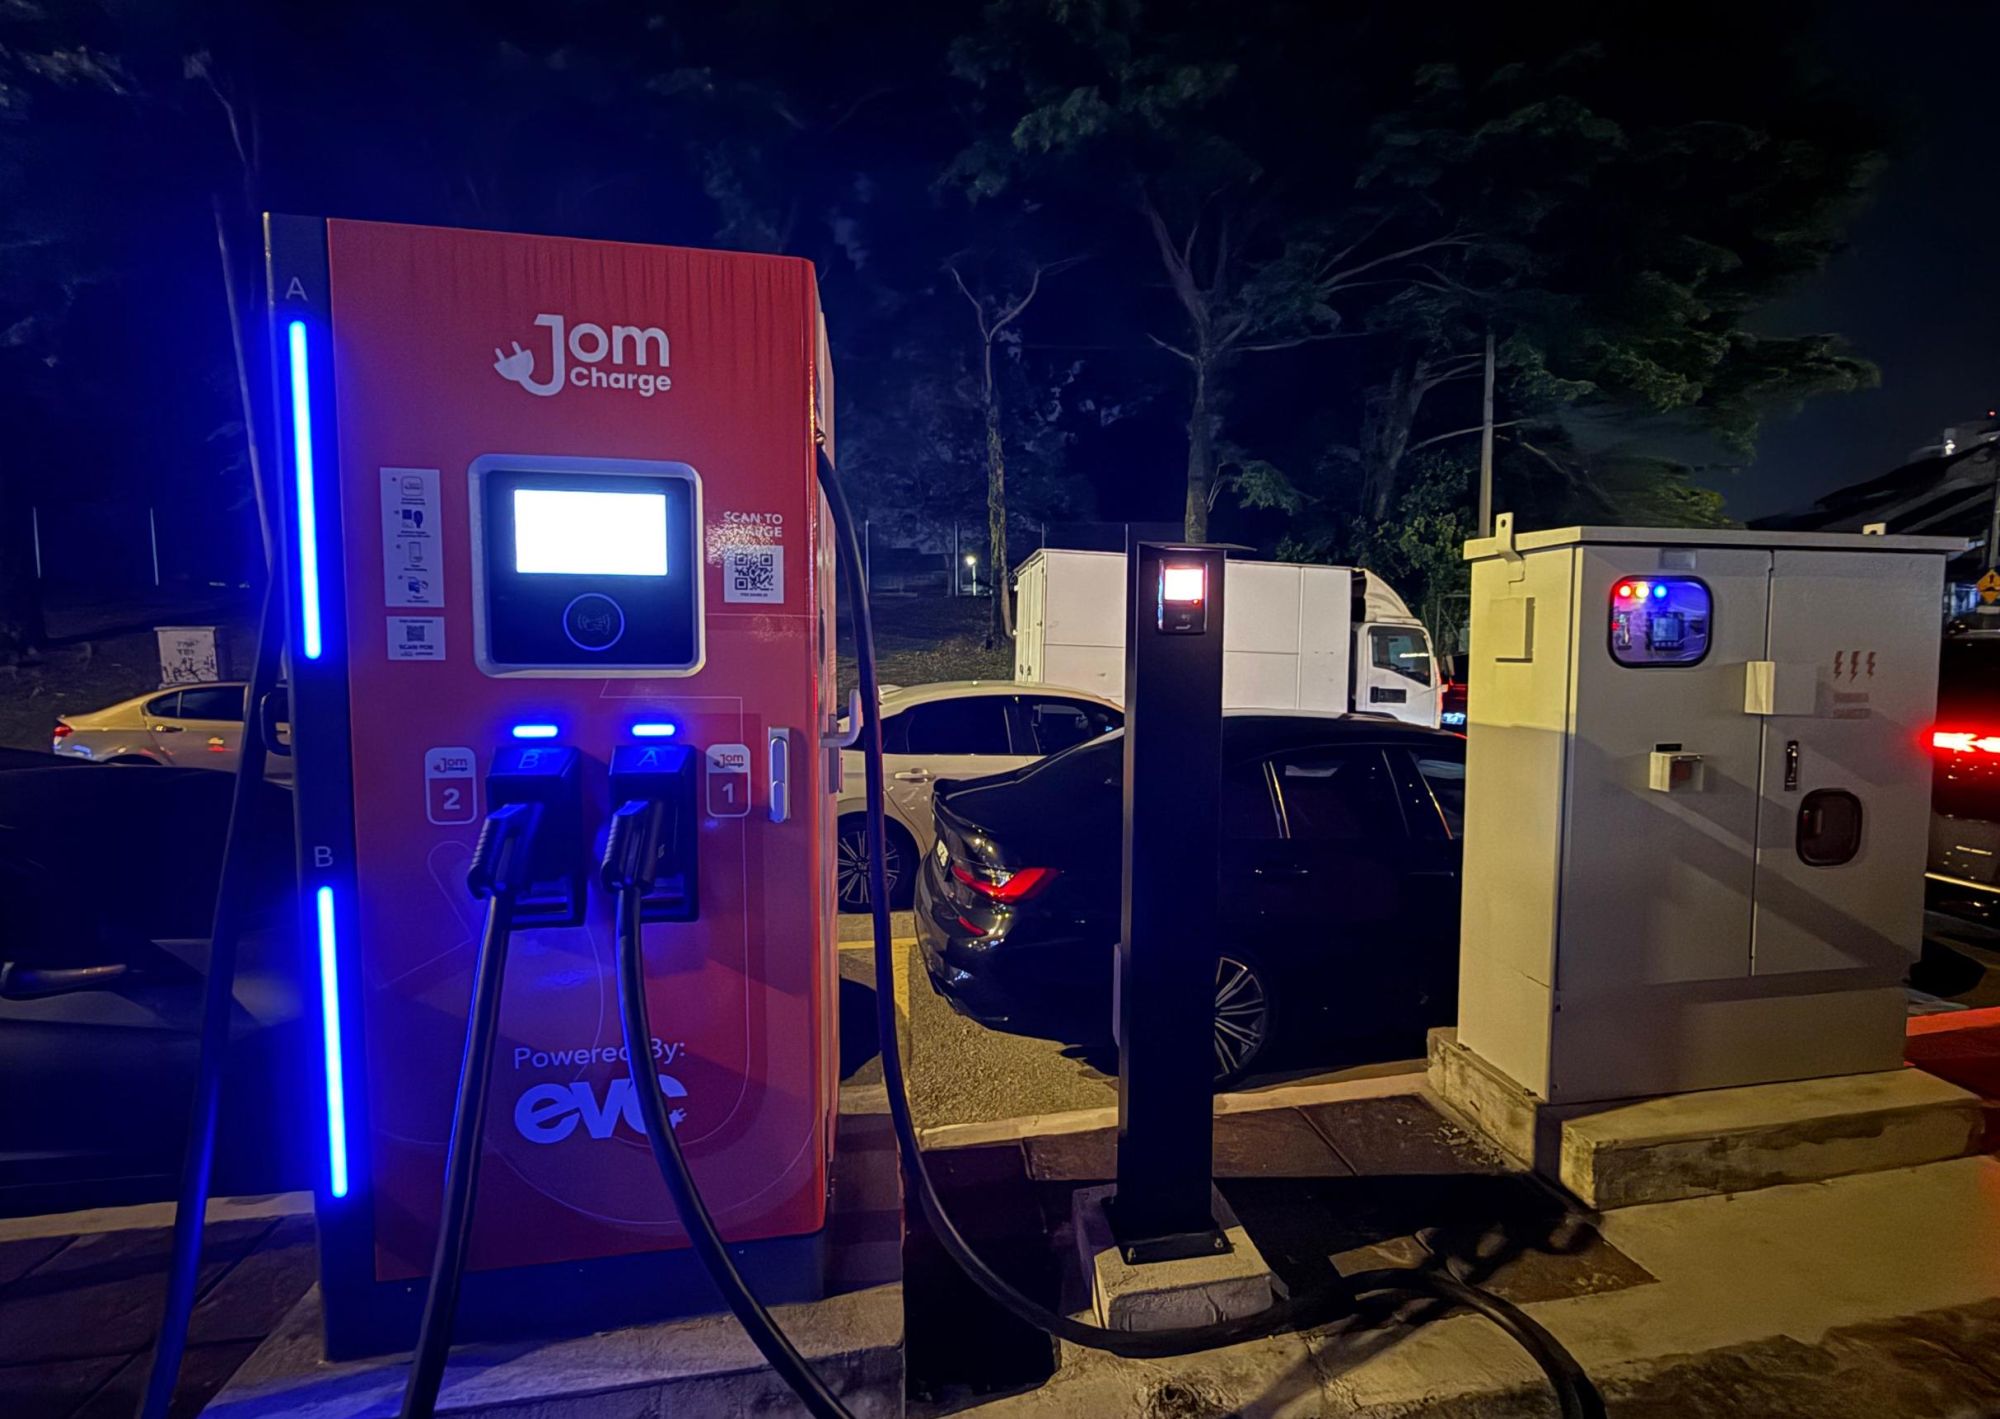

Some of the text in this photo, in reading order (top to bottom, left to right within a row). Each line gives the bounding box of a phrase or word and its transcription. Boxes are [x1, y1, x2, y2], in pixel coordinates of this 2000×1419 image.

[286, 276, 308, 301] A
[520, 314, 670, 397] Jom
[570, 366, 672, 397] Charge
[723, 511, 783, 525] SCAN TO
[438, 757, 468, 773] Jom
[518, 750, 540, 769] B
[636, 748, 659, 767] A
[718, 753, 745, 769] Jom
[443, 787, 461, 811] 2
[722, 782, 734, 804] 1
[314, 846, 334, 868] B
